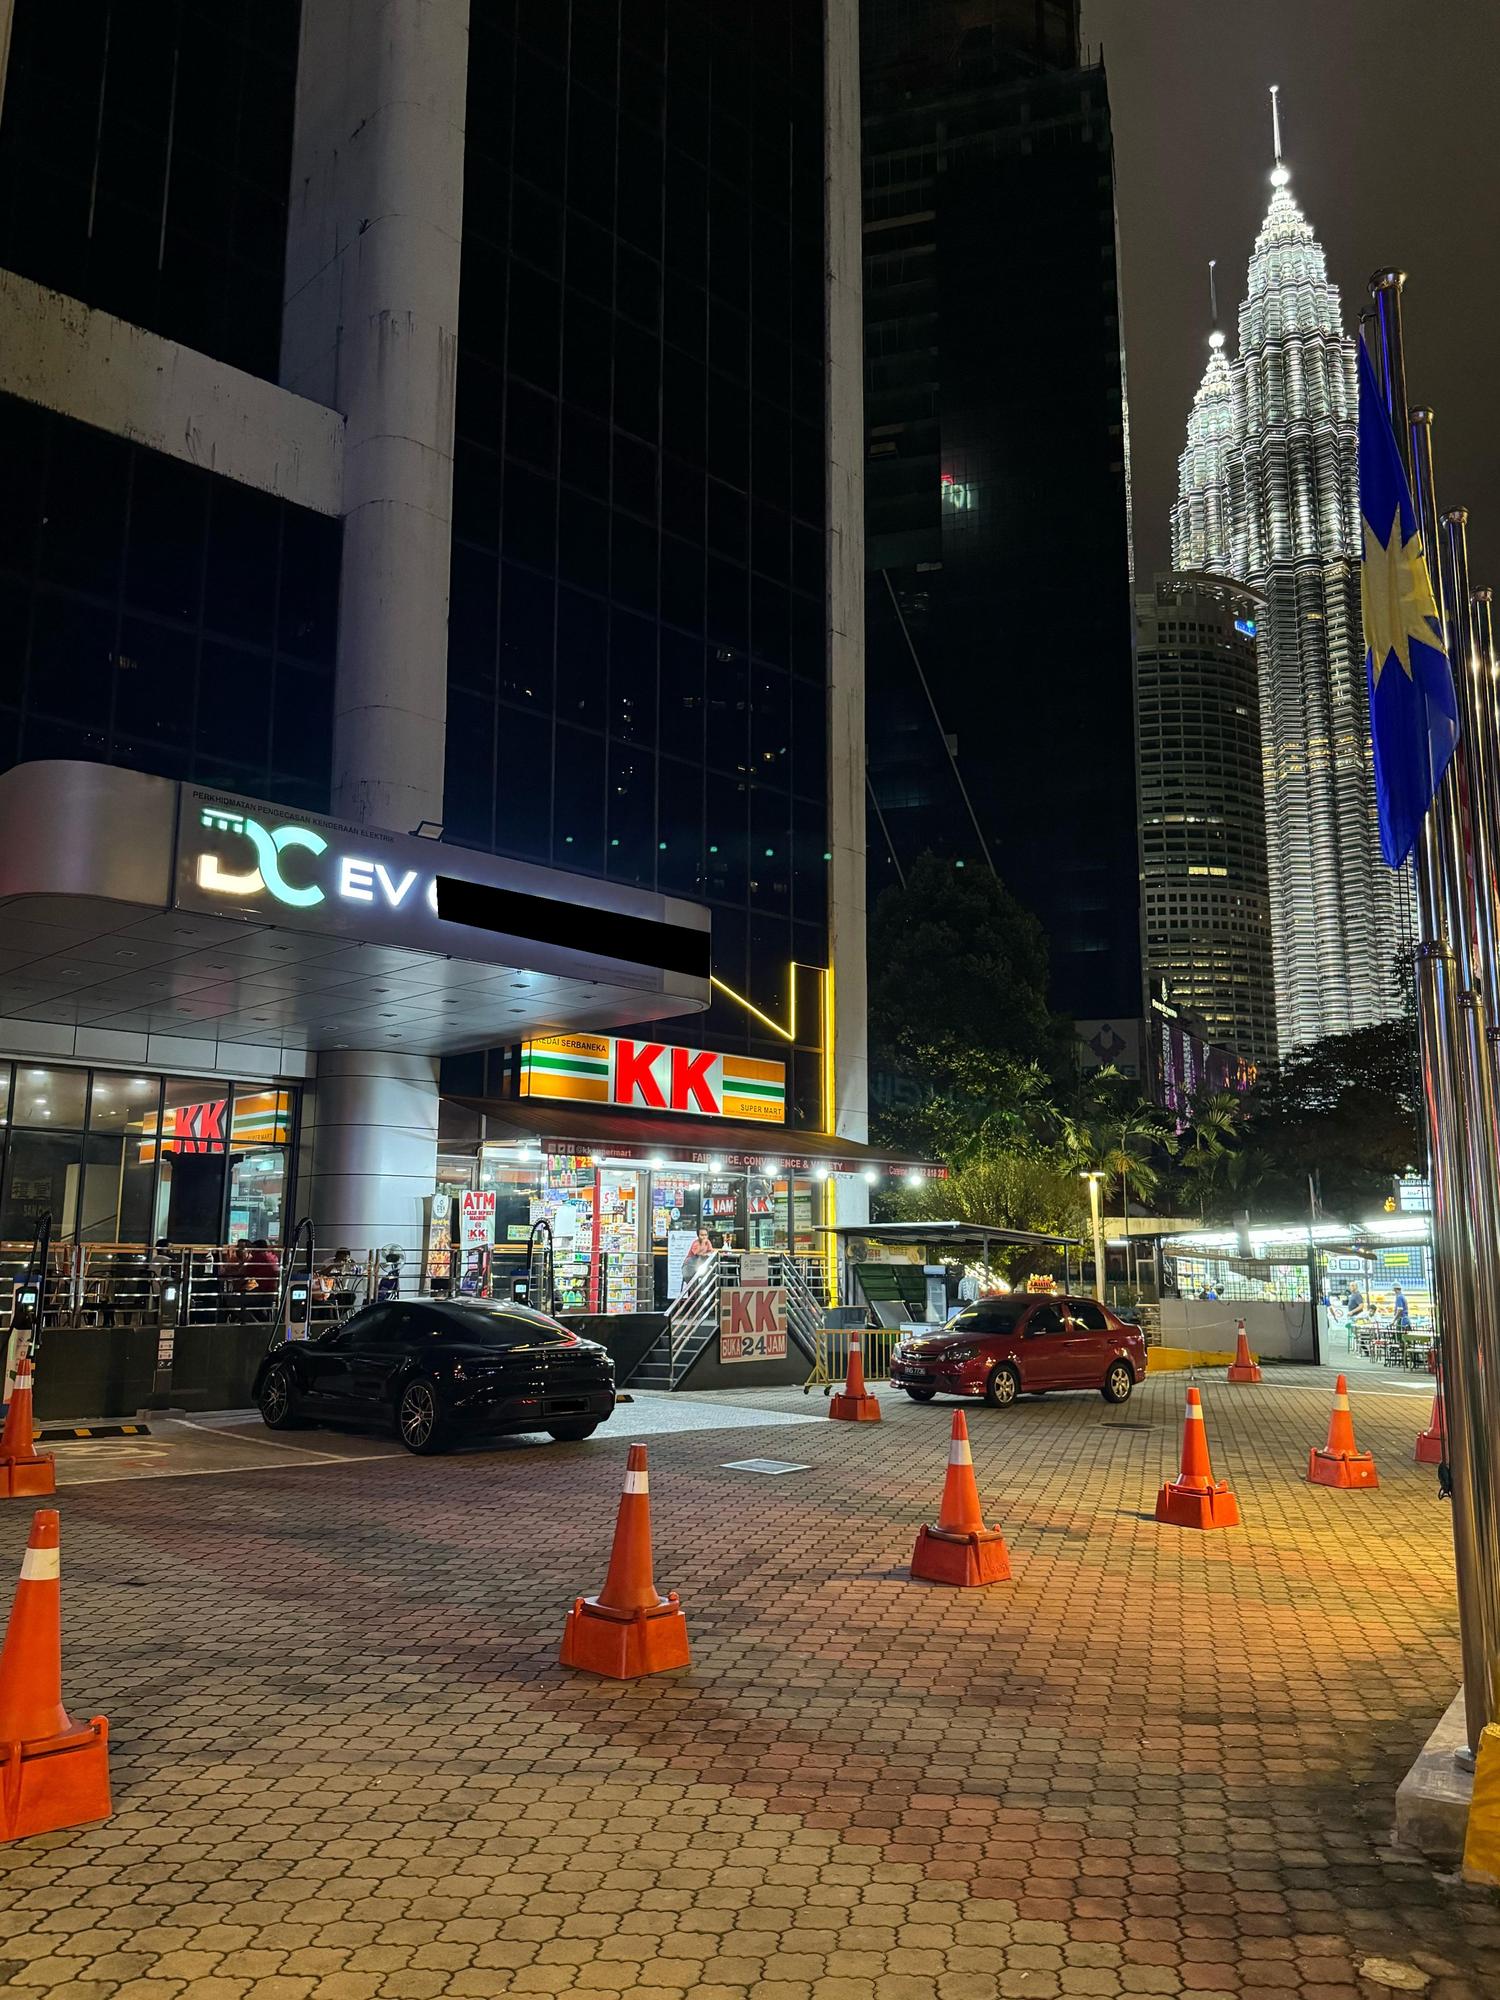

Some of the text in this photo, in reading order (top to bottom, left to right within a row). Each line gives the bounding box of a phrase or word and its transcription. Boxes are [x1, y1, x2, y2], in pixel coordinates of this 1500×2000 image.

[193, 790, 256, 812] PERKHIDMATAN
[312, 818, 359, 835] KENDERAAN
[360, 829, 395, 843] ELEKTRIK
[340, 856, 419, 907] EV
[561, 1039, 607, 1053] SERBANEKA
[614, 1039, 721, 1113] KK
[740, 1103, 762, 1114] SUPER
[763, 1107, 782, 1116] MART
[174, 1100, 228, 1154] KK
[692, 1152, 712, 1163] FAIR
[714, 1153, 742, 1166] RICE,
[743, 1156, 801, 1169] CONVIENCE
[803, 1160, 809, 1169] &
[463, 1192, 495, 1210] ATM
[714, 1198, 734, 1213] JAM
[469, 1229, 486, 1237] KK
[731, 1290, 778, 1334] KK
[722, 1335, 786, 1357] BUKA 24 JAM
